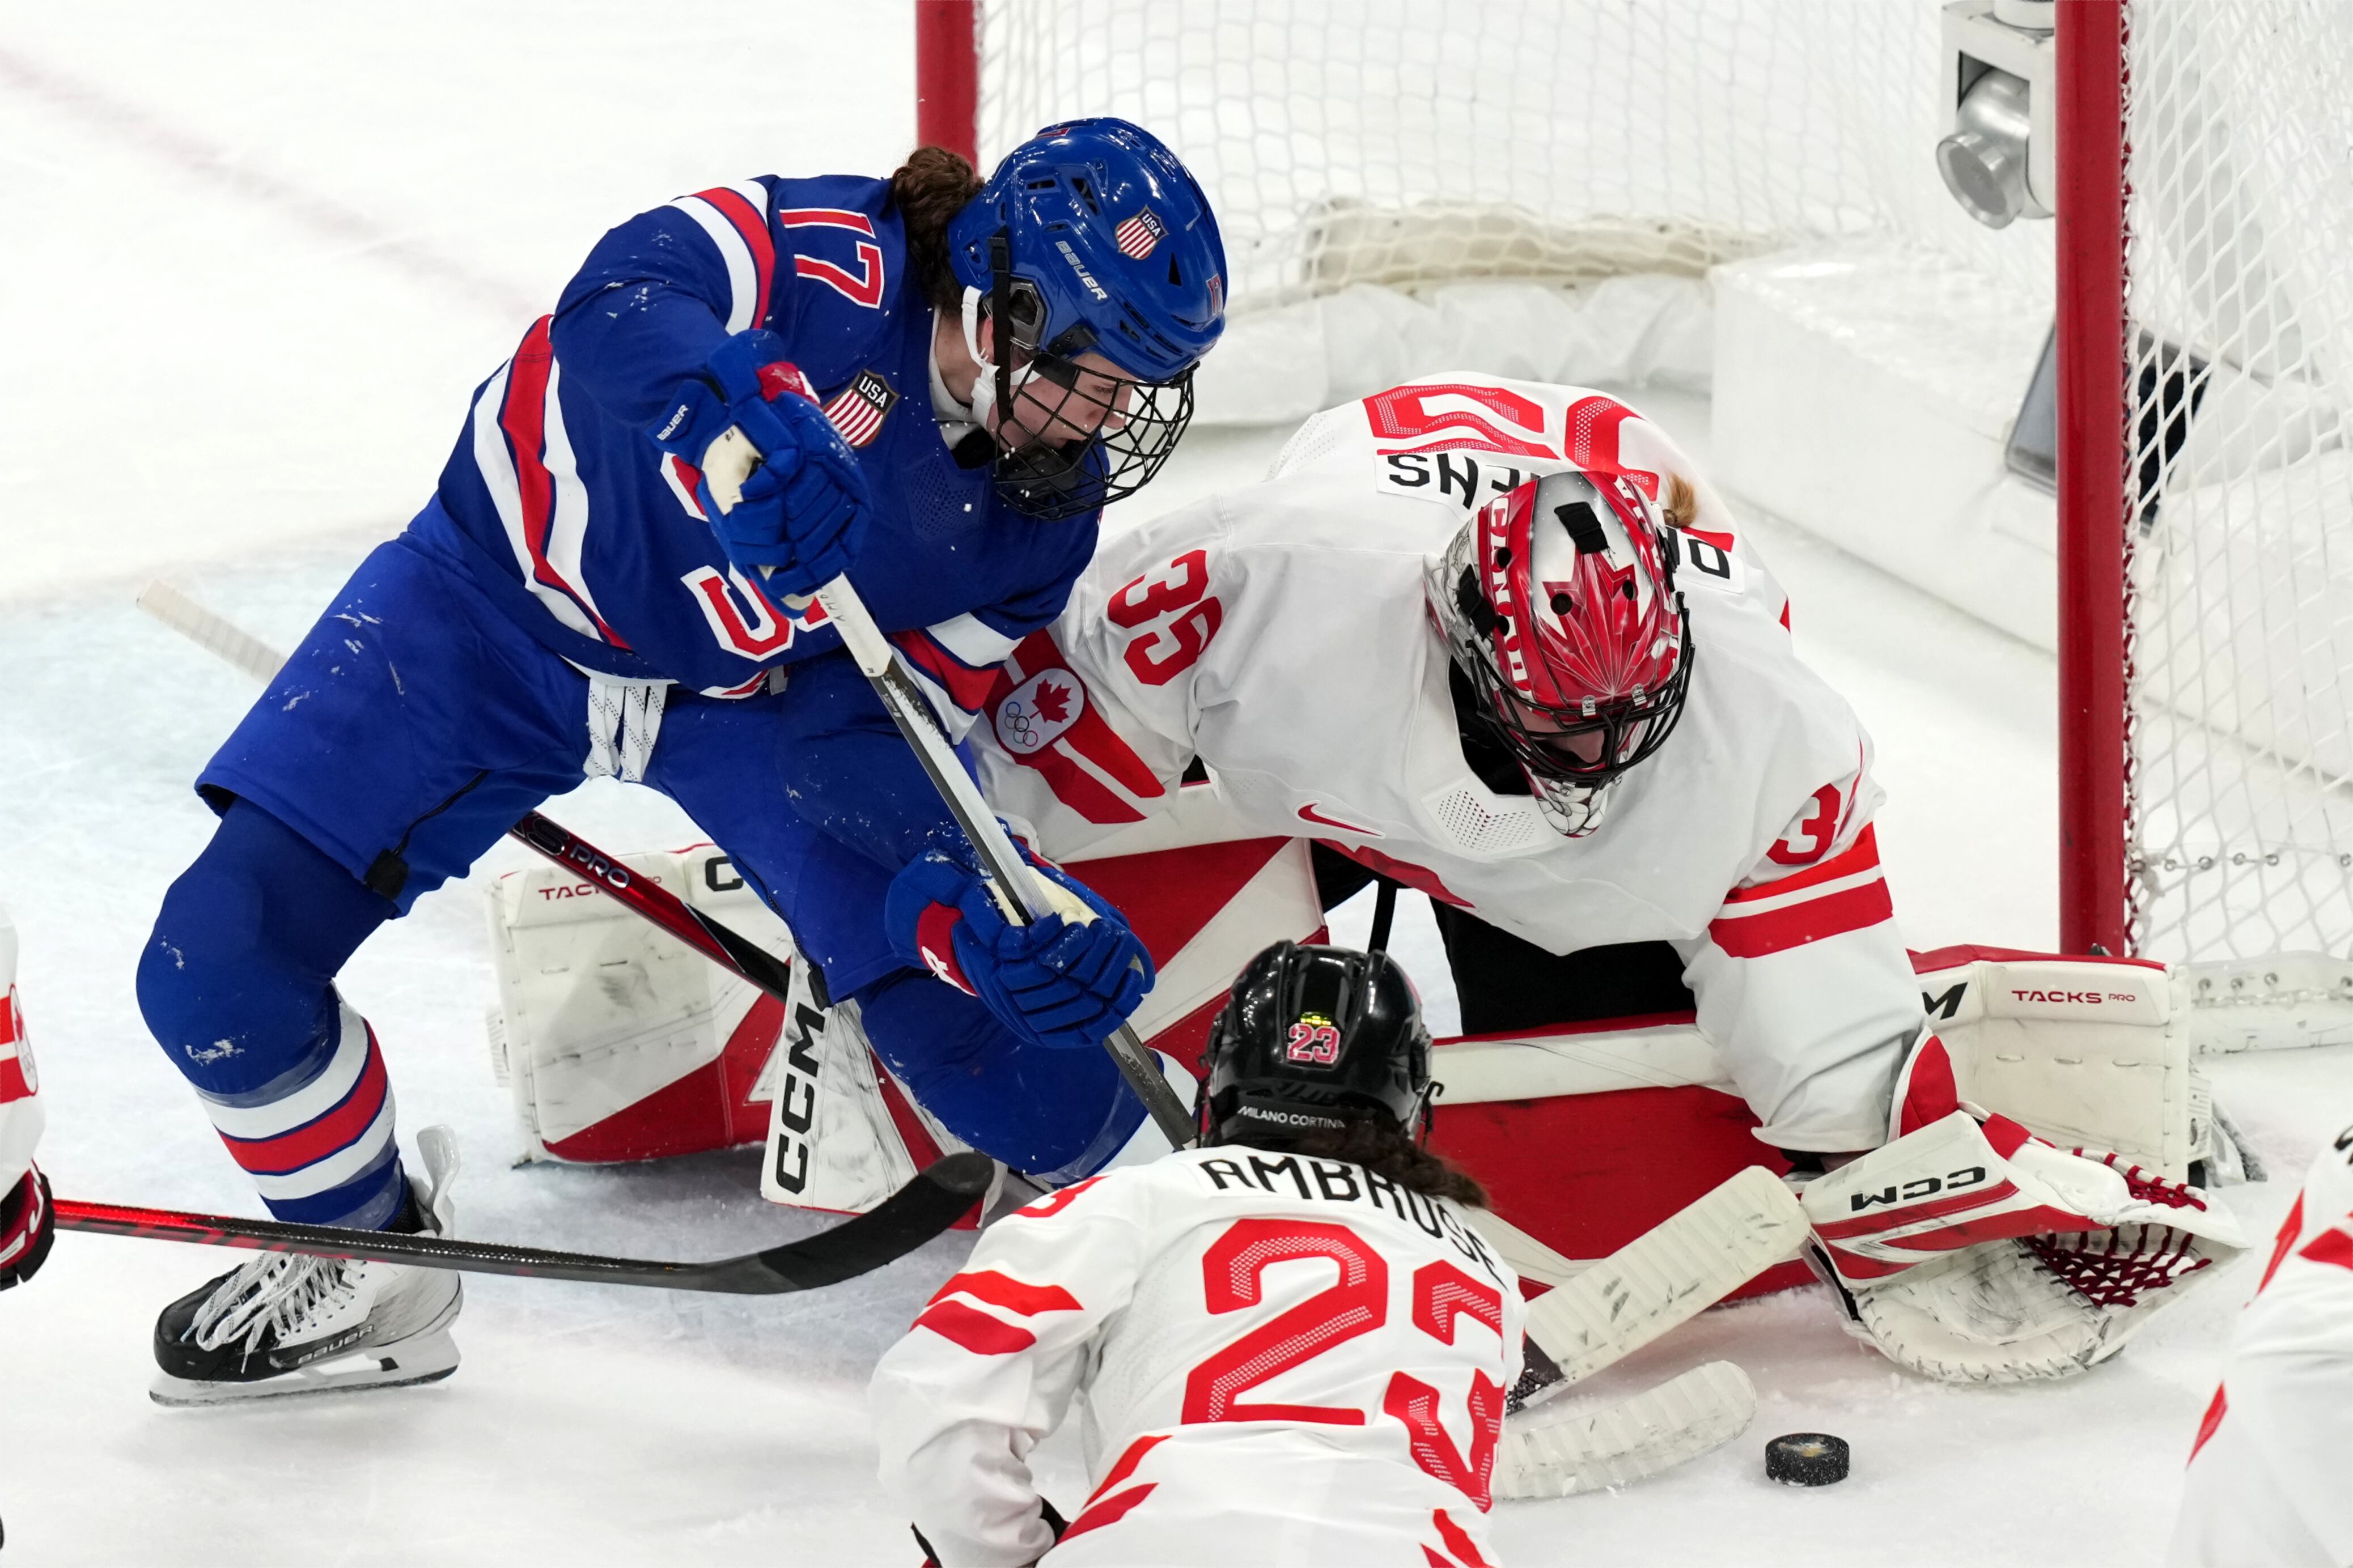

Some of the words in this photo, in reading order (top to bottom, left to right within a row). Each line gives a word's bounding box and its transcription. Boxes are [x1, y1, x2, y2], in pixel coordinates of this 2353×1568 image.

[1142, 213, 1160, 237] USA
[779, 207, 885, 309] 17
[858, 375, 888, 409] USA
[1108, 549, 1223, 686] 35
[569, 843, 631, 889] PRO
[2011, 990, 2102, 1004] TACKS
[2108, 993, 2136, 1002] PRO
[1287, 1023, 1341, 1064] 23
[776, 1002, 825, 1195] CCM
[1237, 1106, 1288, 1123] MILANO
[1289, 1114, 1346, 1128] CORTINA
[1851, 1166, 1986, 1212] CCM
